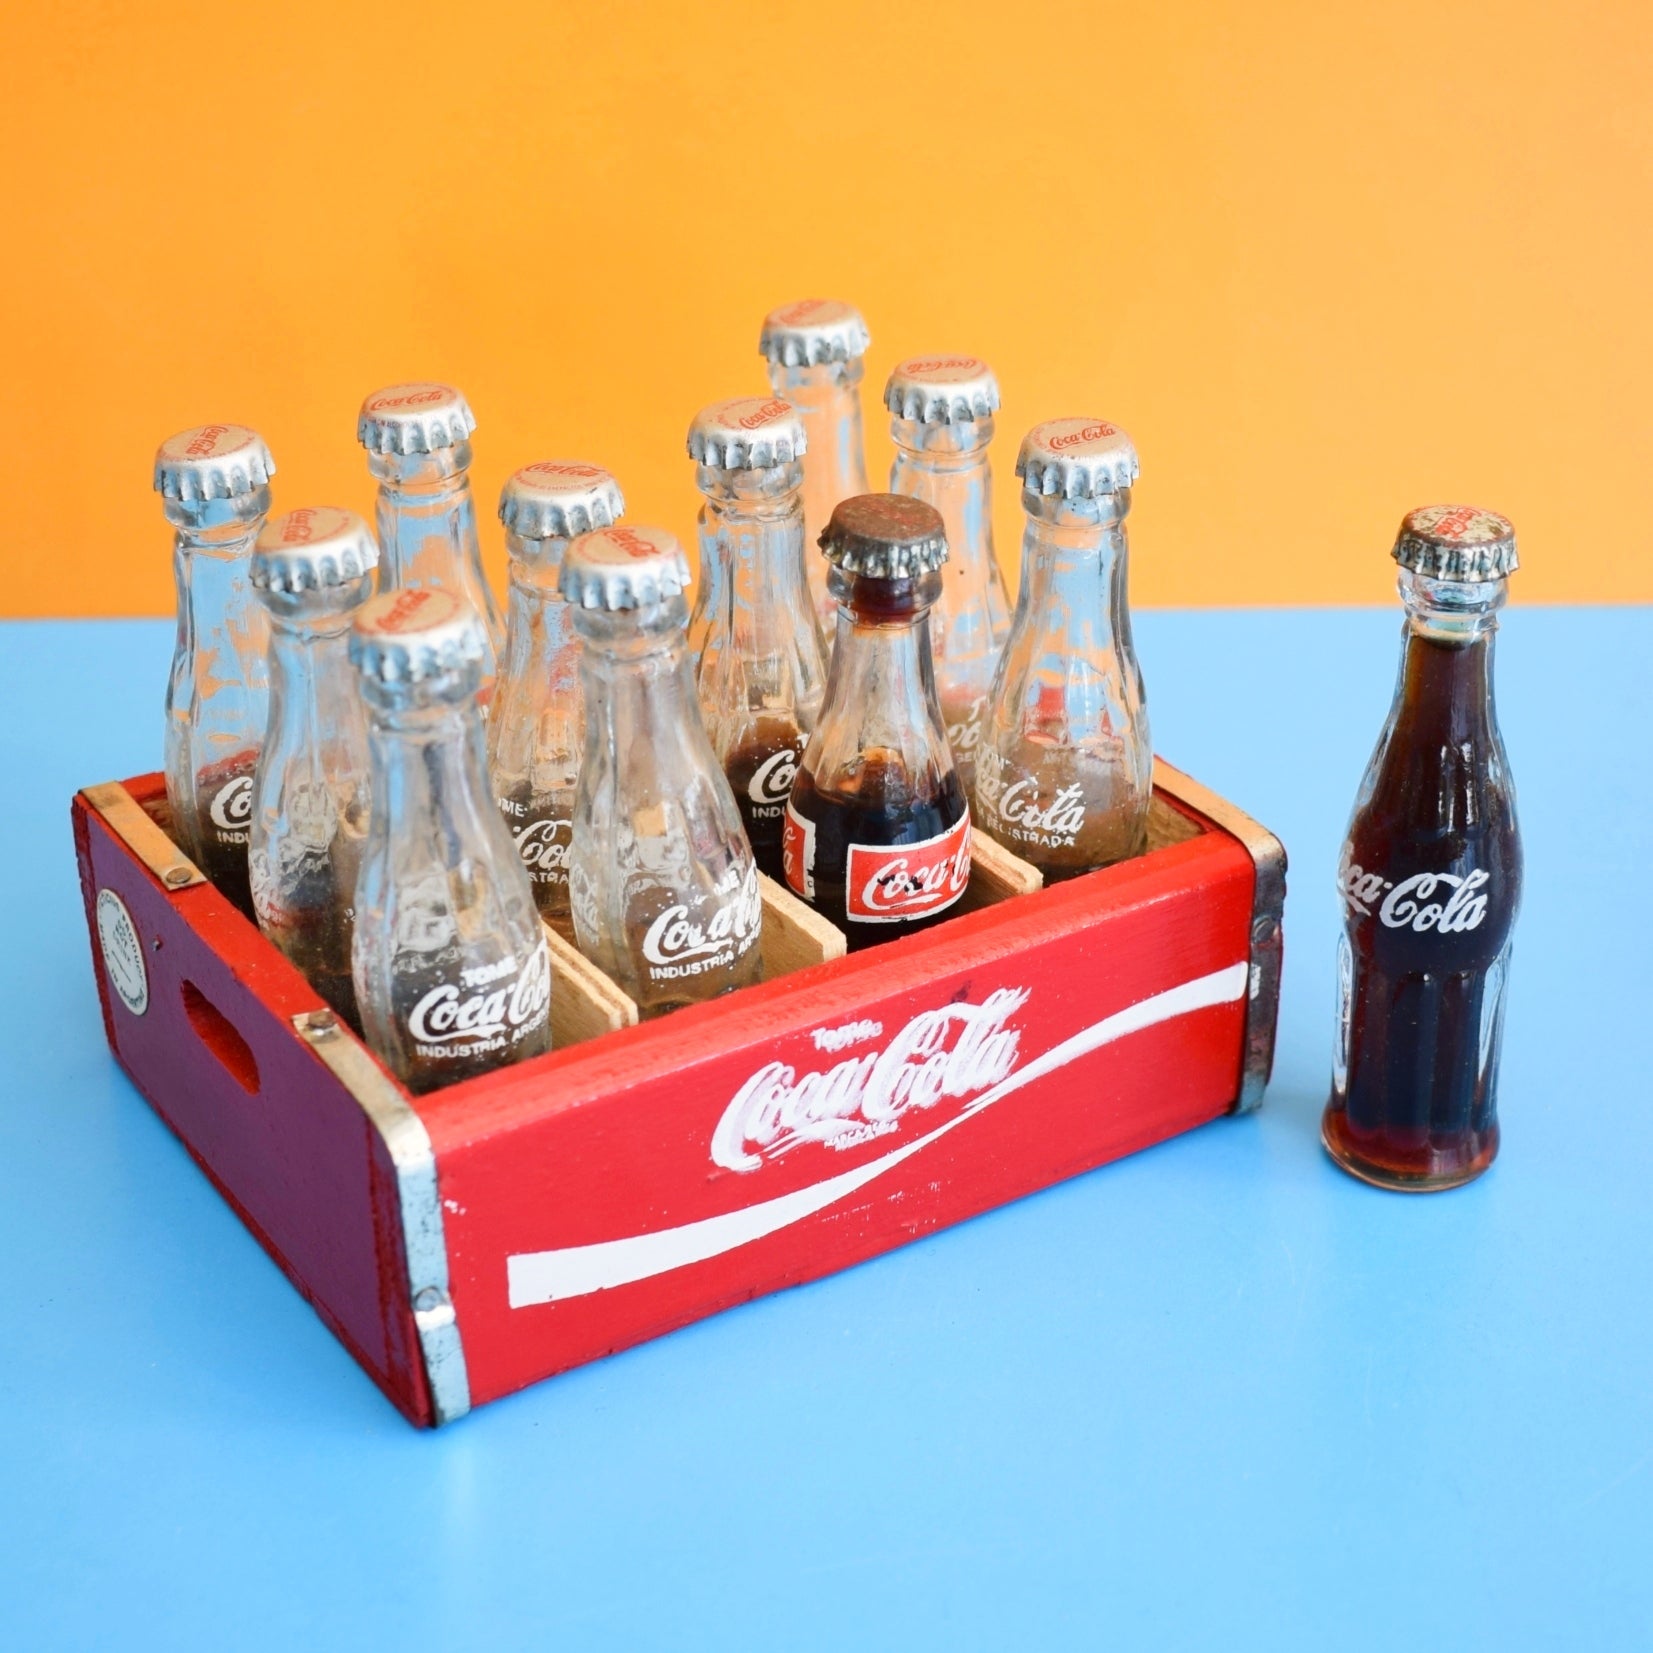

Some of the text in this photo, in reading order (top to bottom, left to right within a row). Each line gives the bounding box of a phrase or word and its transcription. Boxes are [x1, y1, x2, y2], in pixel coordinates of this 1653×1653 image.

[1049, 424, 1116, 450] Coca-Cola
[650, 951, 735, 980] INDUSTRIA
[416, 1034, 508, 1059] INDUSTRIA
